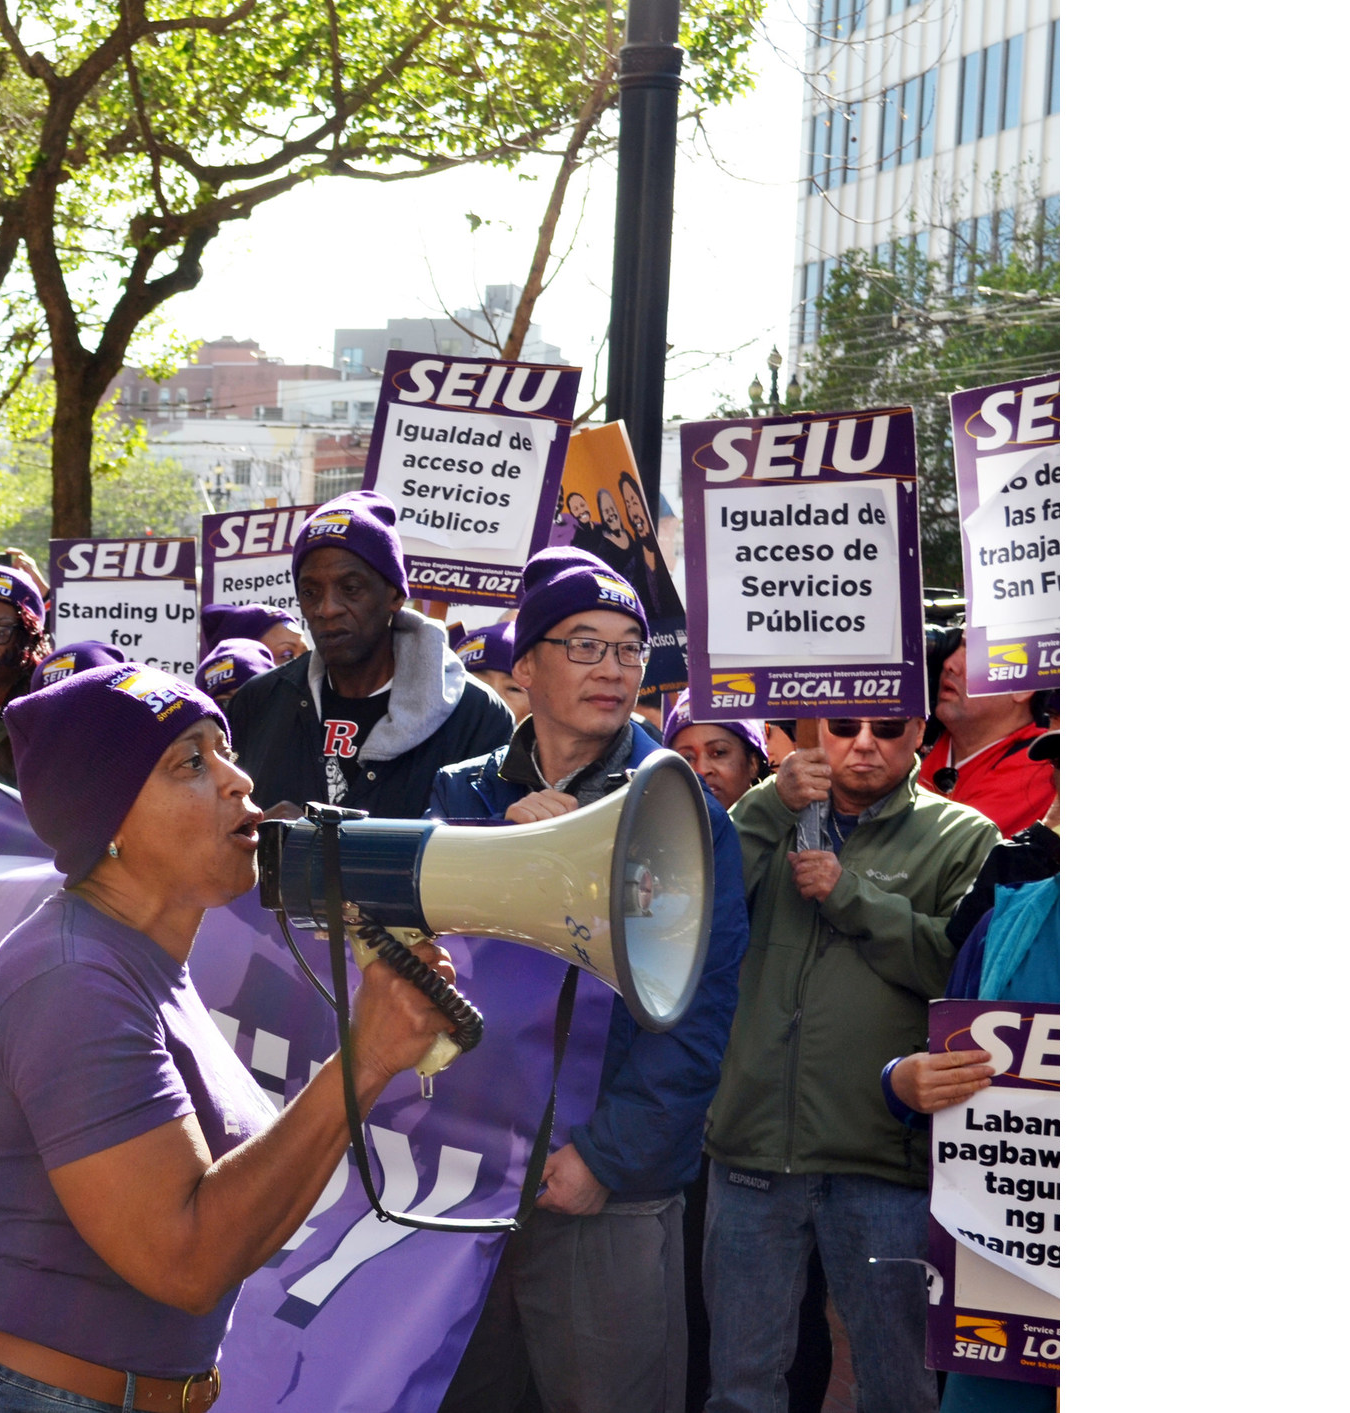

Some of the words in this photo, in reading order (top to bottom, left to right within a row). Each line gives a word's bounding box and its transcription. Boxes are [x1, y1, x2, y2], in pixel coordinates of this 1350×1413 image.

[398, 360, 561, 412] SEIU
[396, 419, 503, 448] Igualdad
[509, 432, 533, 451] de
[706, 416, 890, 483] SEIU
[402, 453, 484, 475] acceso
[491, 460, 521, 480] de
[401, 479, 511, 508] Servicios
[399, 507, 500, 535] Públicos
[721, 503, 849, 532] Igualdad
[858, 503, 886, 525] de
[1004, 505, 1036, 528] las
[308, 524, 348, 538] SEIU
[64, 541, 181, 579] SEIU
[735, 543, 834, 562] acceso
[843, 538, 878, 561] de
[410, 560, 430, 568] Service
[432, 562, 463, 571] Employees
[464, 566, 504, 575] International
[223, 569, 292, 592] Respect
[408, 568, 471, 588] LOCAL
[477, 575, 520, 593] 1021
[741, 575, 872, 597] Servicios
[993, 577, 1035, 601] San
[599, 588, 637, 609] SEIU
[58, 602, 158, 623] Standing
[165, 604, 196, 624] Up
[746, 609, 866, 632] Públicos
[110, 629, 143, 647] for
[43, 668, 74, 686] SEIU
[207, 669, 234, 690] SEIU
[794, 671, 832, 679] Employees
[833, 670, 879, 678] International
[881, 669, 902, 677] Union
[987, 664, 1028, 681] SEIU
[768, 680, 845, 698] LOCAL
[853, 679, 901, 697] 1021
[711, 694, 756, 709] SEIU
[323, 719, 359, 758] R
[970, 1011, 1060, 1081] SE
[985, 1171, 1060, 1201] tagu
[1006, 1208, 1045, 1234] ng
[1023, 1323, 1054, 1335] Service
[953, 1341, 1007, 1362] SEIU
